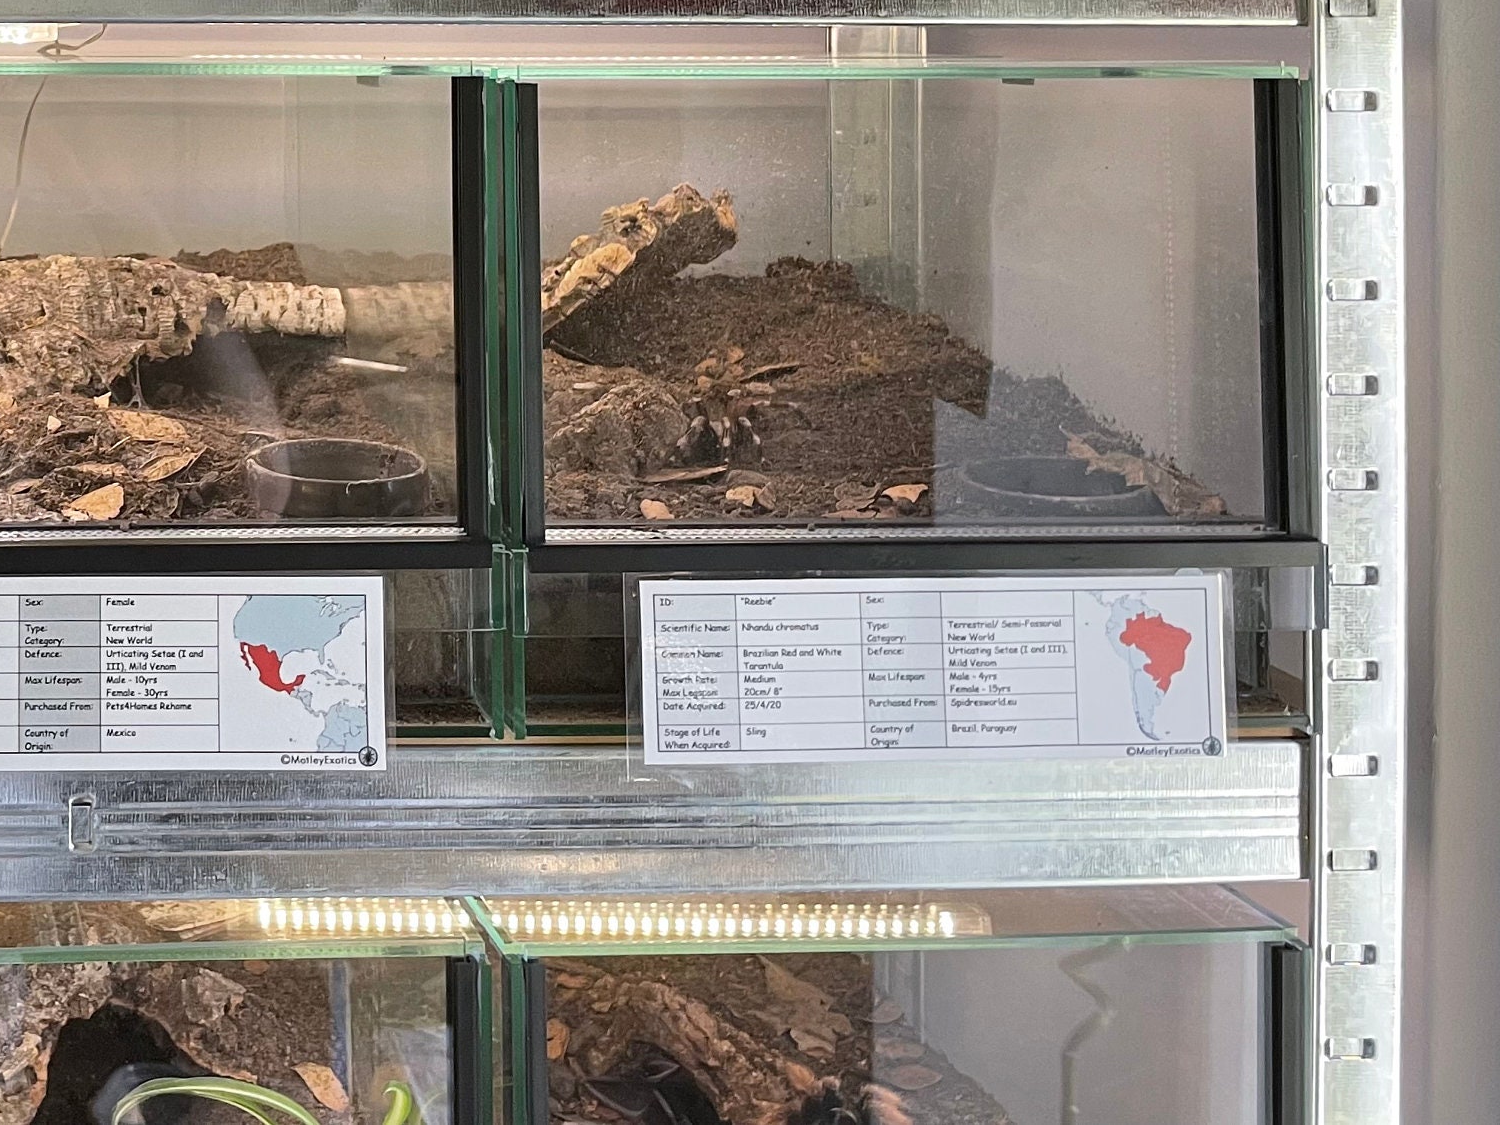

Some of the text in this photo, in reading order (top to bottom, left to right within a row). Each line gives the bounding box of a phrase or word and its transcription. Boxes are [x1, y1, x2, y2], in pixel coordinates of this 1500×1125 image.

[106, 598, 135, 607] Female
[106, 623, 152, 633] Terrestrial
[742, 622, 819, 632] Nhandu chromatus
[106, 636, 152, 645] New World
[949, 658, 998, 667] Mild Venom
[744, 675, 776, 683] Medium
[744, 700, 782, 709] 25/4/20
[106, 729, 136, 737] Mexico
[746, 727, 766, 737] Sling
